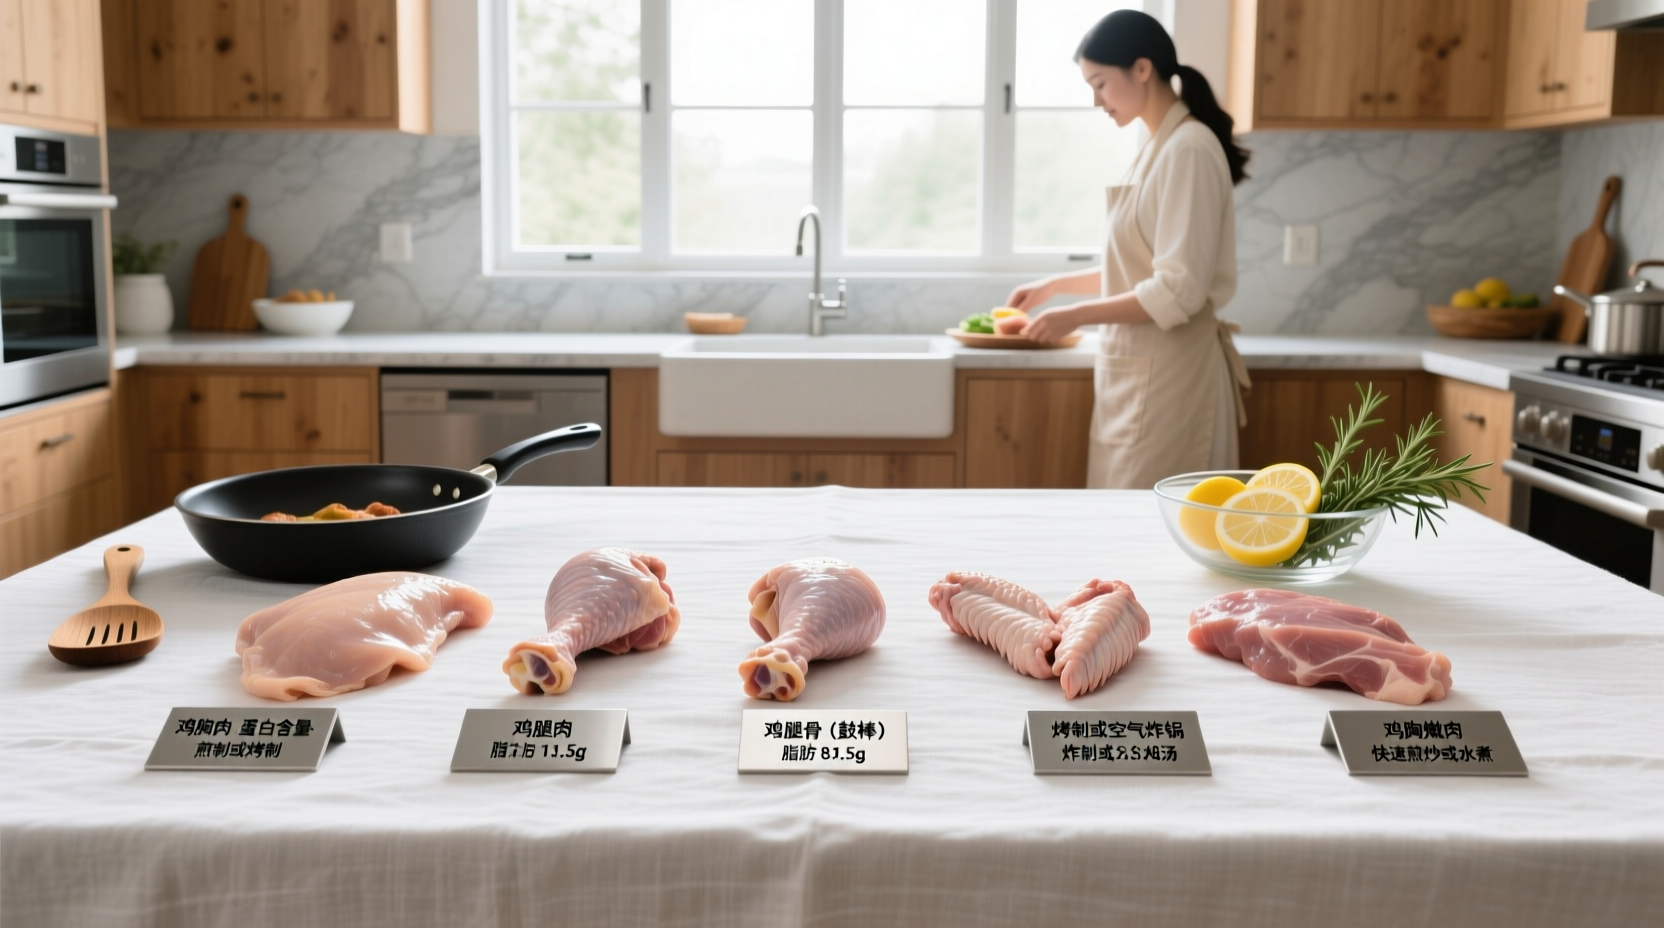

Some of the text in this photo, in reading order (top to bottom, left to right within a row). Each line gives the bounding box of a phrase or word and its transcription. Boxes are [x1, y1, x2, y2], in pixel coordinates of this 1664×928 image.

[175, 718, 232, 736] 鸡胸肉
[512, 719, 573, 738] 鸡腿肉
[1051, 719, 1185, 739] 烤制或空气炸锅
[781, 743, 817, 762] 脂肪
